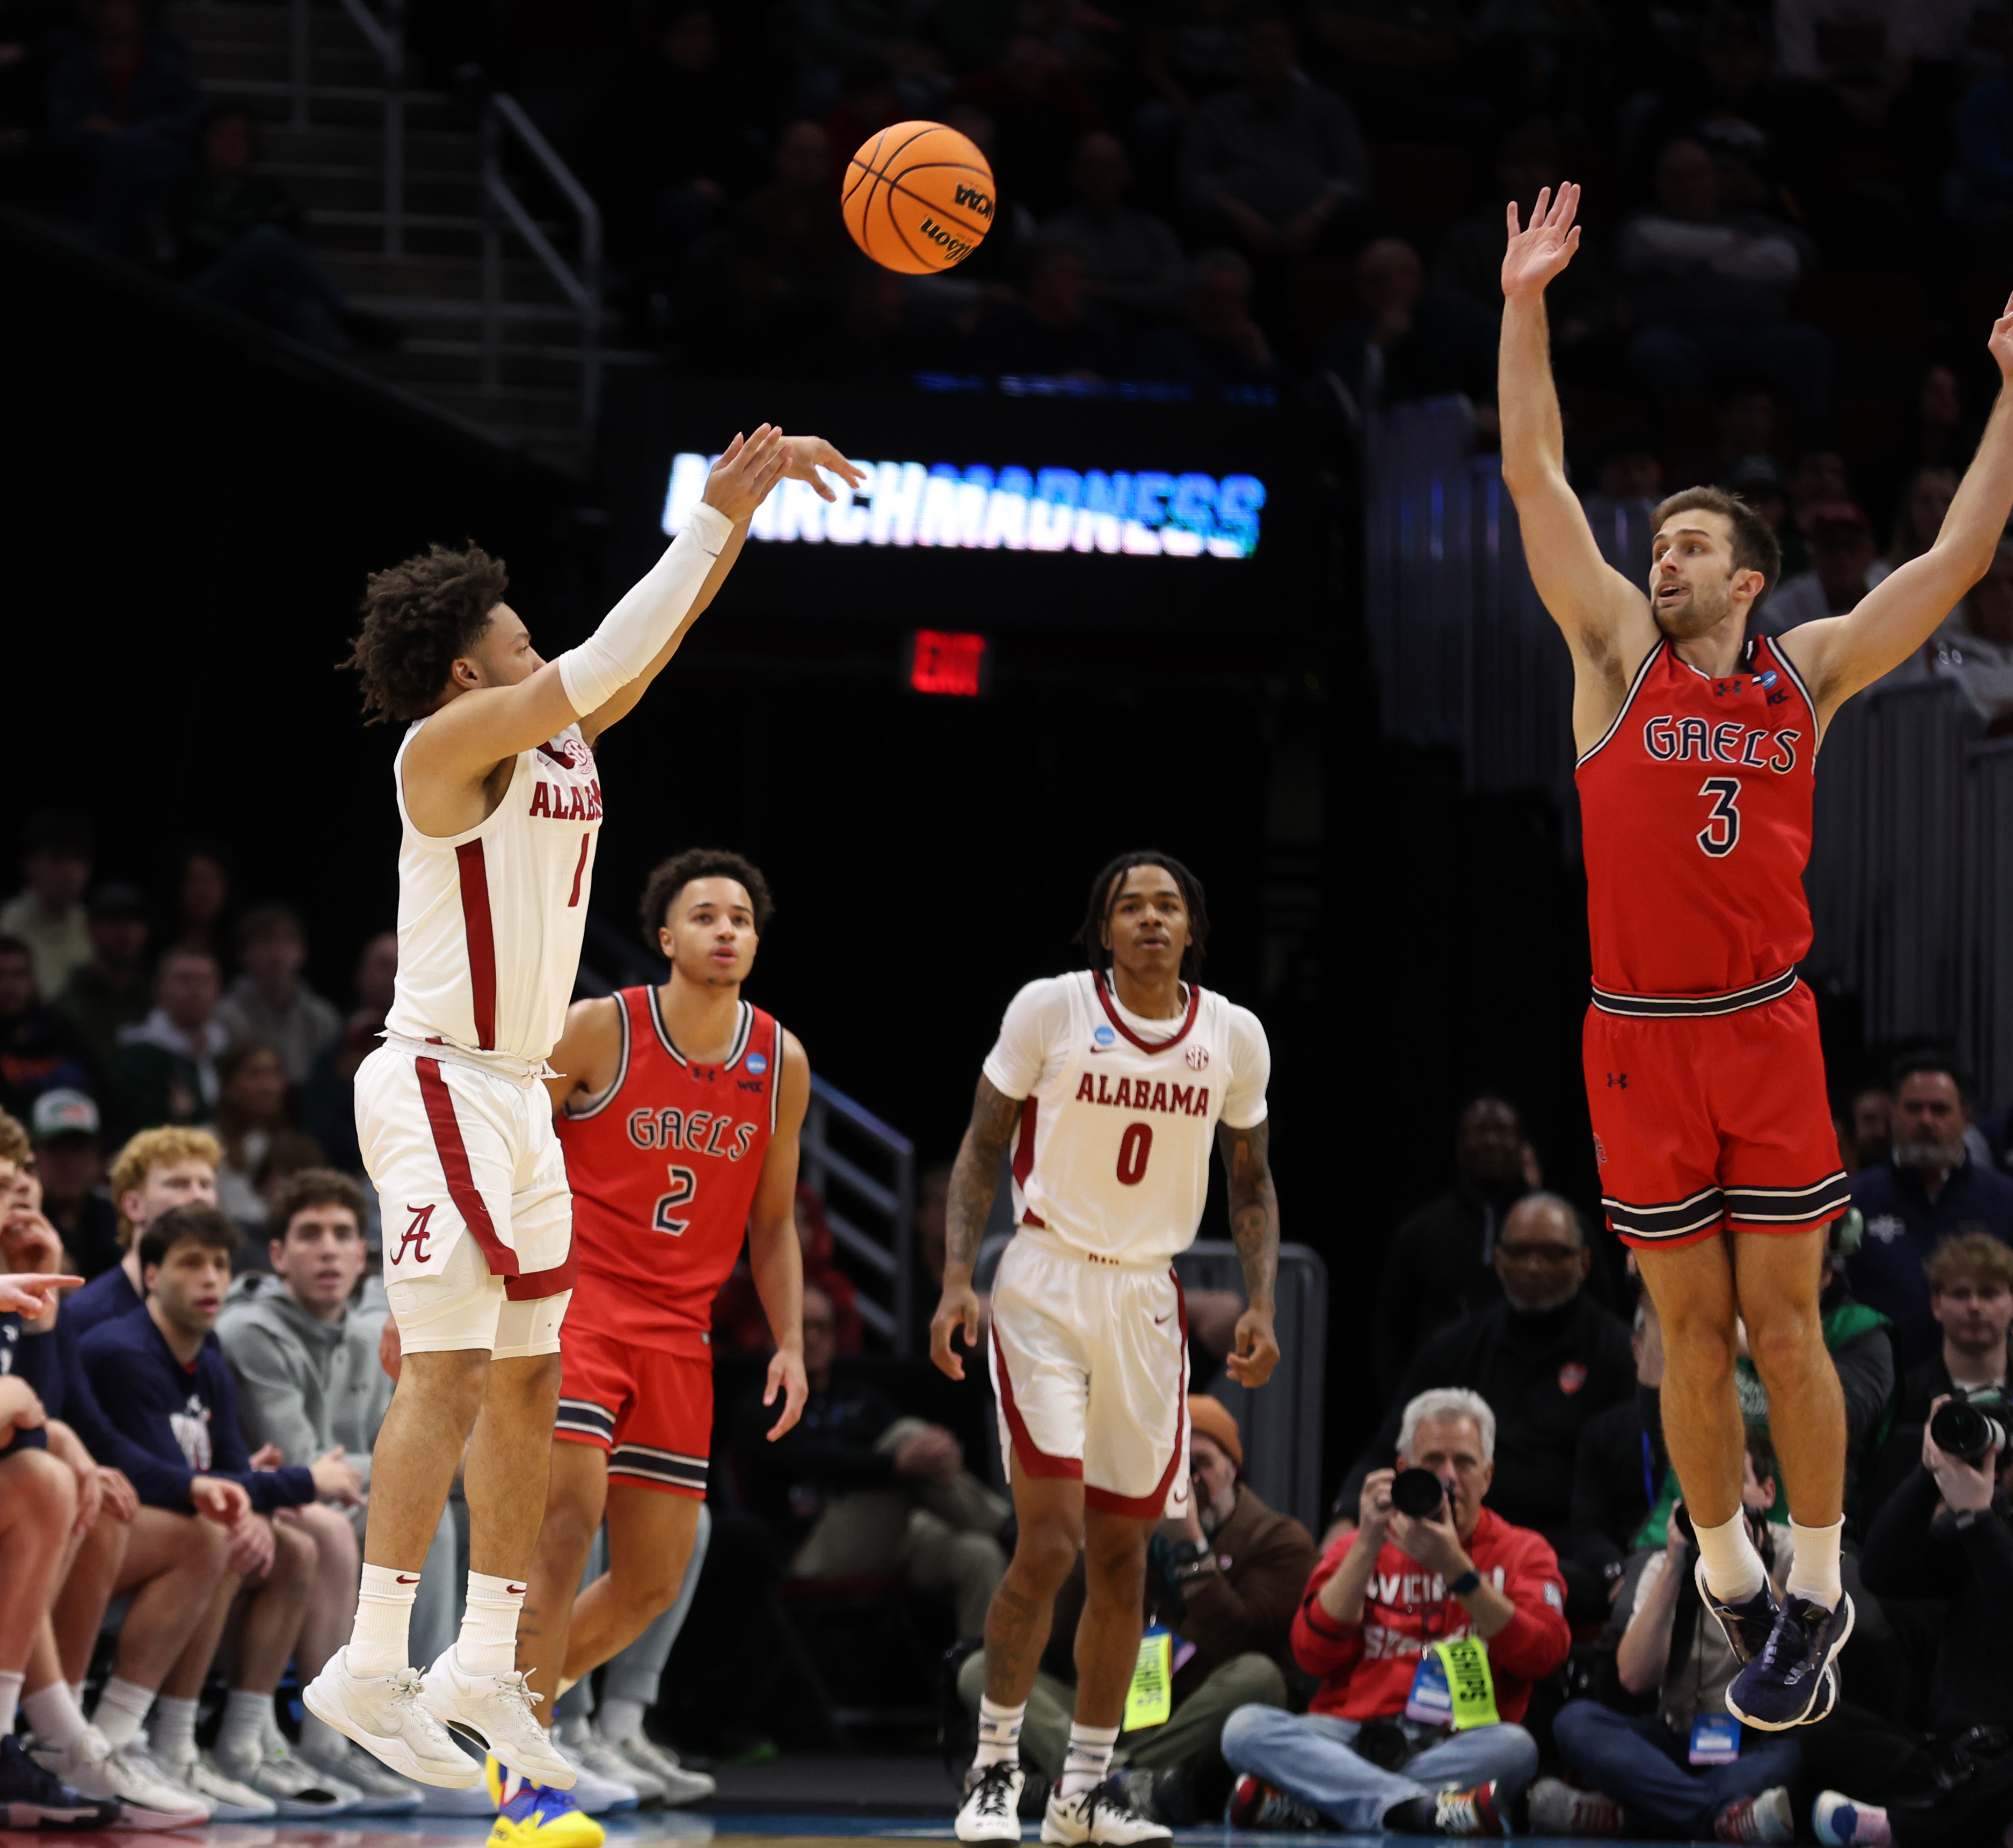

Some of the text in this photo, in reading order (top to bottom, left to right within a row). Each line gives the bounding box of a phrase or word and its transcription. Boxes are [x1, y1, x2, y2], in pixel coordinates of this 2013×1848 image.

[1644, 715, 1801, 774] GAELS
[1696, 776, 1742, 858] 3
[568, 832, 590, 907] 1
[1076, 1072, 1209, 1117] ALABAMA
[627, 1107, 758, 1162] GAELS
[1116, 1121, 1153, 1186] 0
[652, 1163, 697, 1236] 2
